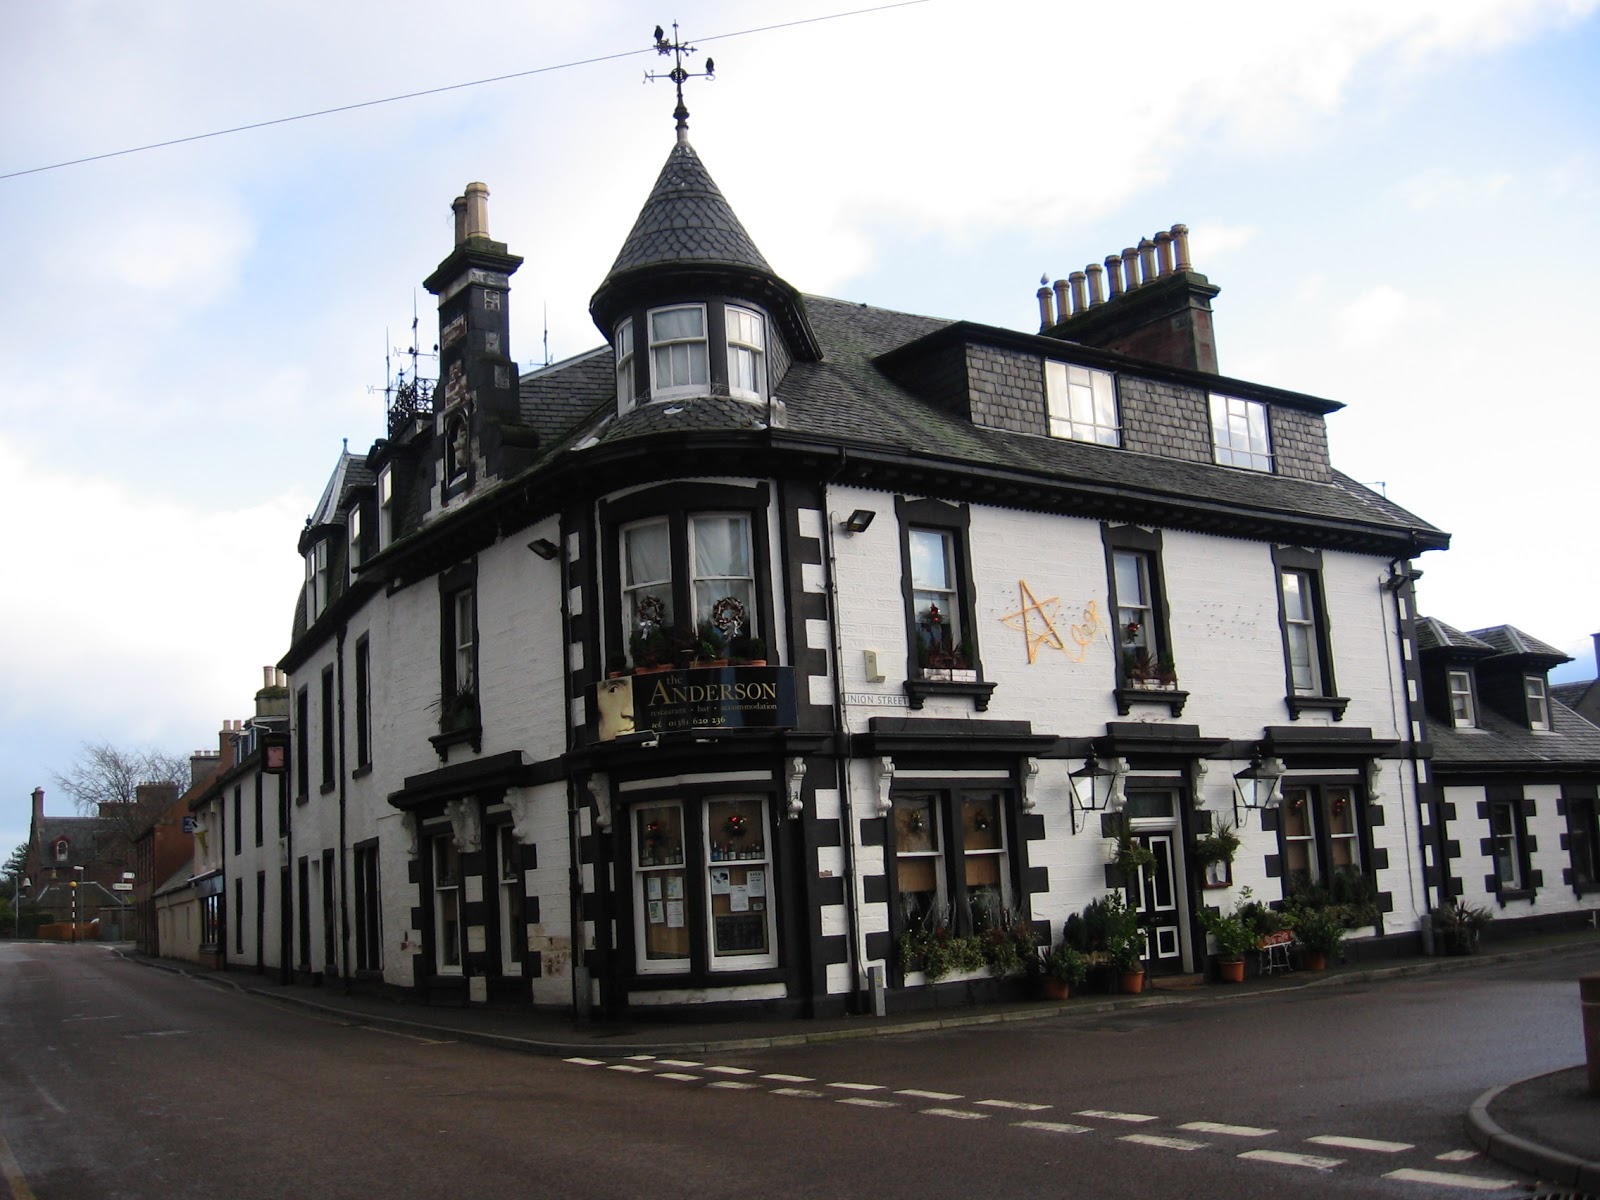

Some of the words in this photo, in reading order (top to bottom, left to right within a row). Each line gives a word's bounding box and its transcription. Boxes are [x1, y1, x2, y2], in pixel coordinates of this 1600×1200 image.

[667, 675, 682, 684] the
[648, 680, 777, 706] ANDERSON
[877, 696, 908, 705] STREET
[651, 708, 687, 716] restaurant
[720, 702, 778, 711] accommodation
[669, 718, 689, 727] 01381
[692, 717, 708, 725] 620
[711, 715, 726, 725] 236
